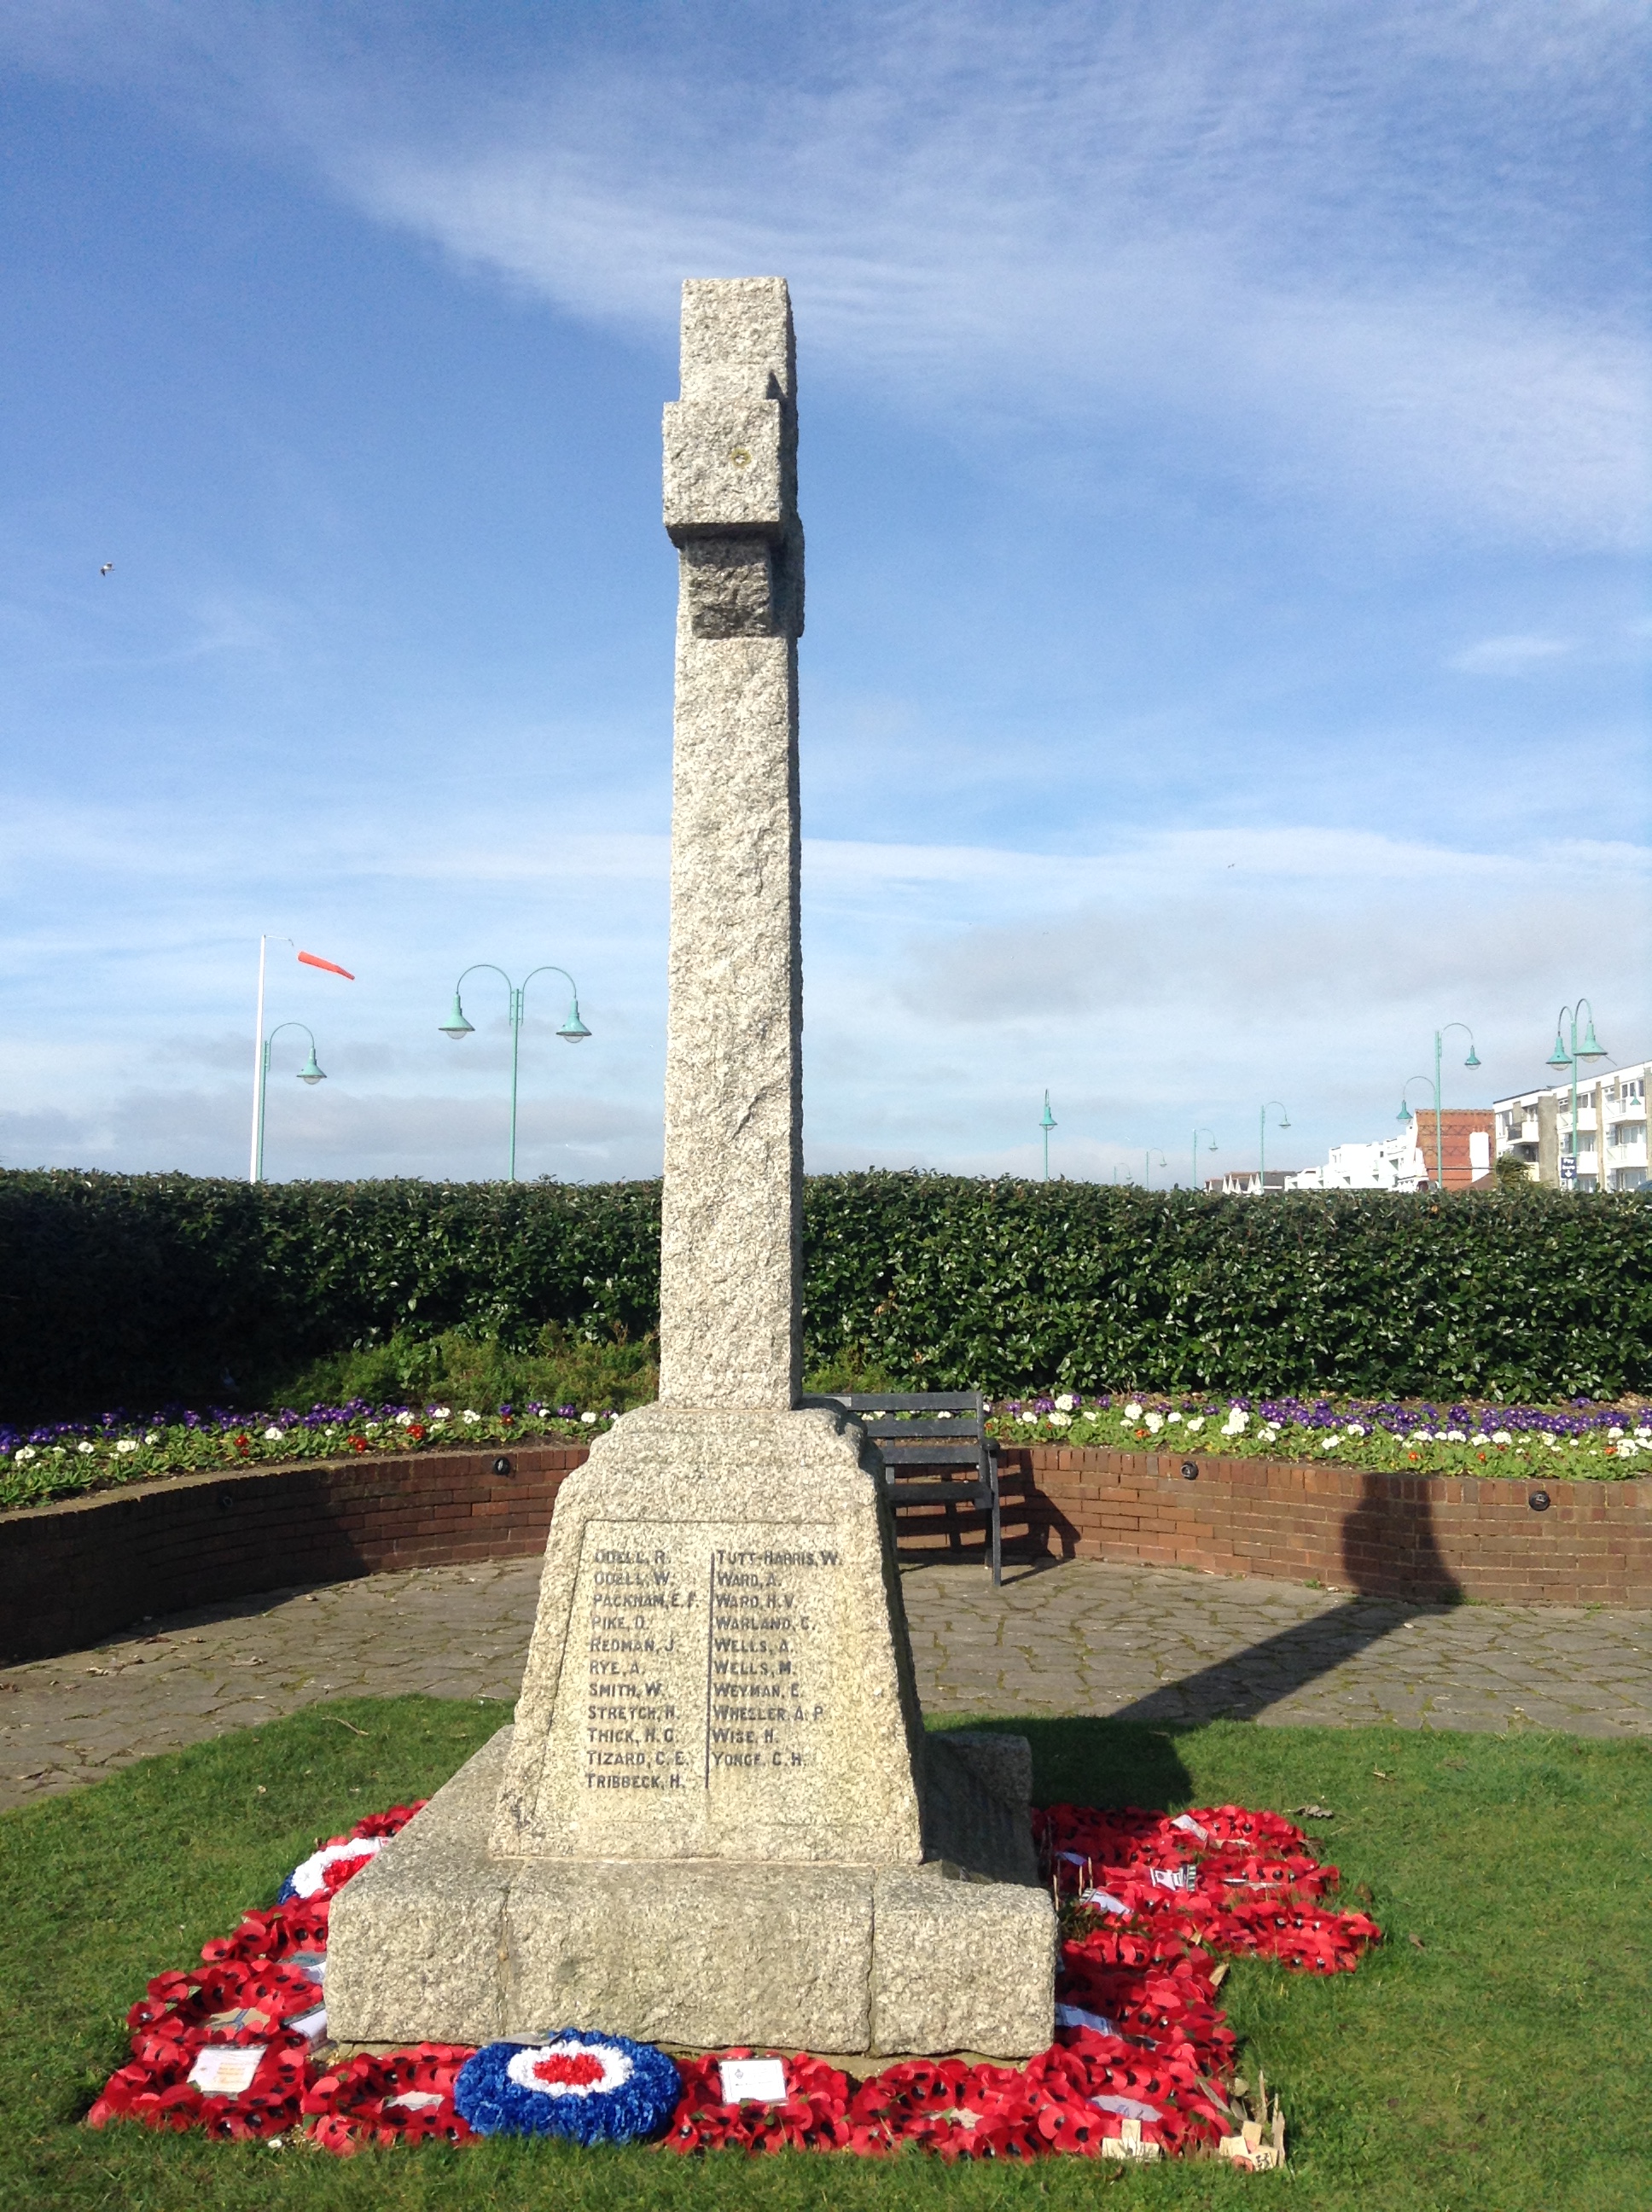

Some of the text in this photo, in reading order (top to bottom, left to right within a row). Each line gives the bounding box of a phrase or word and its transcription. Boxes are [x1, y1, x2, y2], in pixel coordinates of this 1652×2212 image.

[593, 1593, 668, 1610] PACKHAM,
[592, 1615, 630, 1632] PIKE,
[590, 1636, 660, 1655] REDMAN,
[714, 1638, 794, 1656] WELLS, A.
[590, 1660, 645, 1677] RYE, A.
[713, 1660, 796, 1678] WELLS, M.
[590, 1683, 641, 1698] SMITH,
[588, 1705, 681, 1723] STRETCH, H.
[587, 1726, 639, 1746] THICK,
[764, 1727, 780, 1743] H.
[586, 1749, 689, 1769] TIZARD, C. E.
[771, 1751, 788, 1767] C.
[585, 1773, 685, 1790] TRIBBECK, H.
